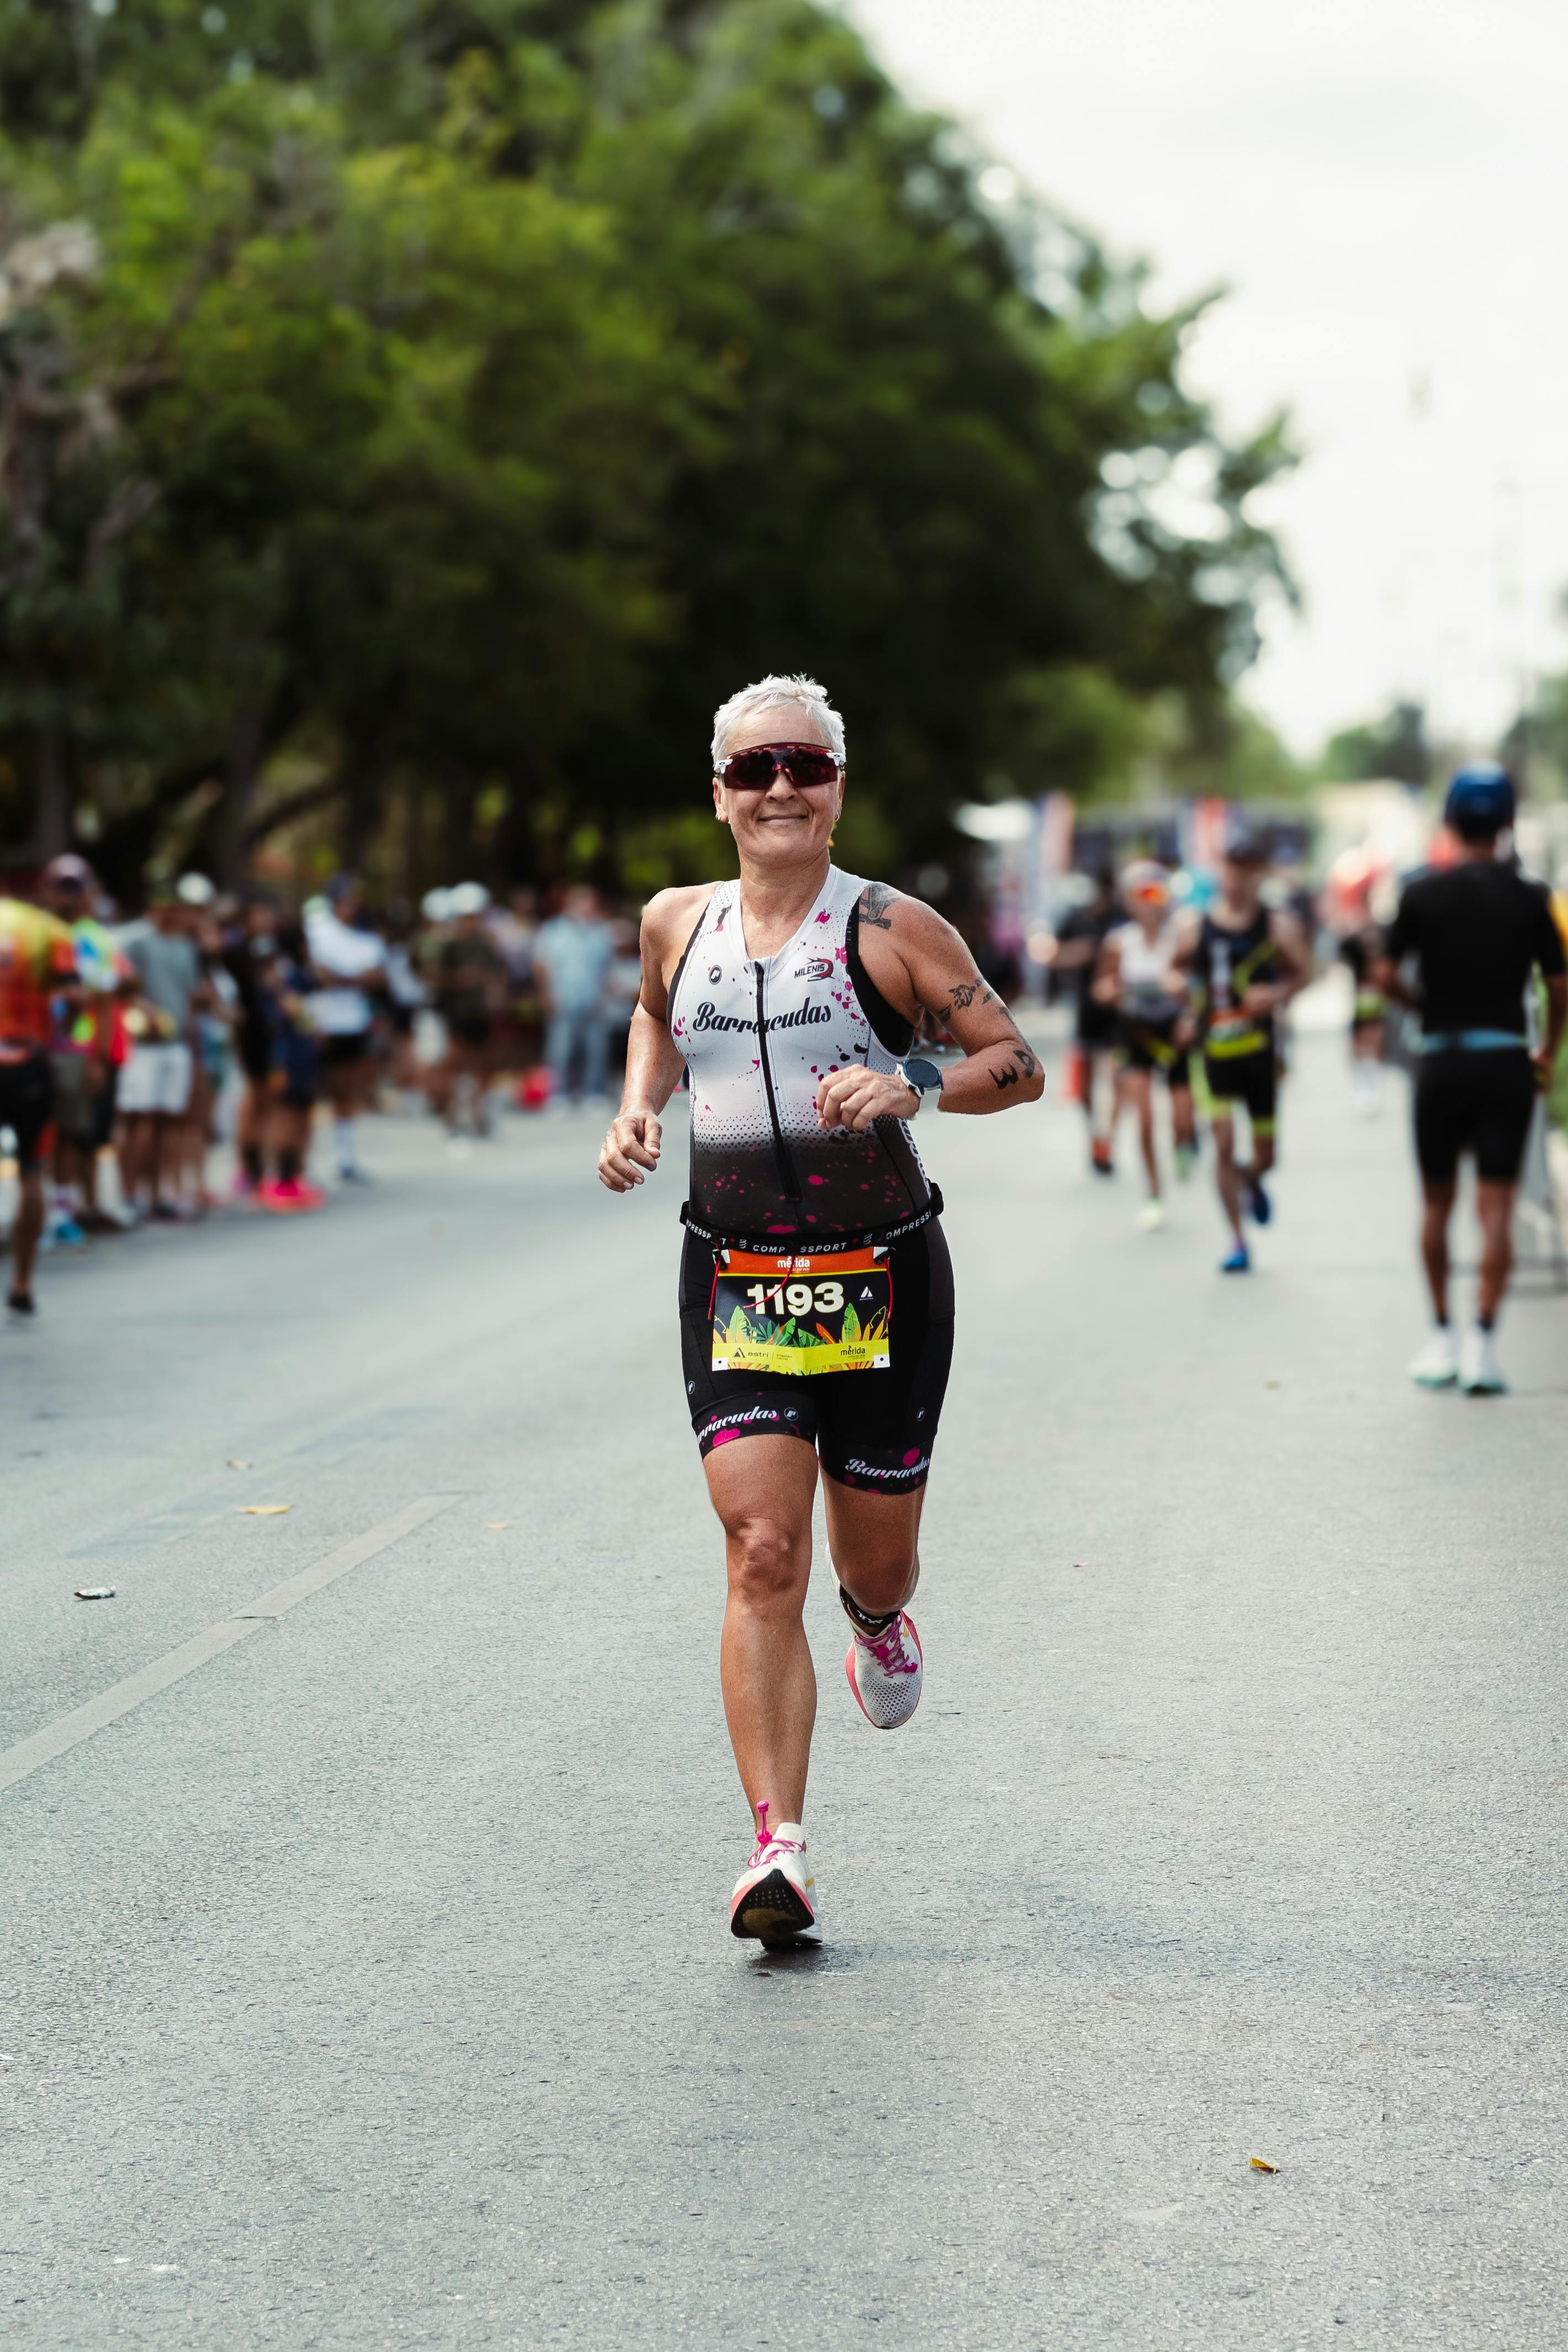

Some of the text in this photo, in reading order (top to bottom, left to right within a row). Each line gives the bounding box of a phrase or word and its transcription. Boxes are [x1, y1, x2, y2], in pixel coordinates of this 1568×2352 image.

[794, 963, 825, 979] MILENIS
[692, 997, 831, 1034] Barracudas
[777, 1256, 811, 1268] méida
[747, 1281, 844, 1316] 1193
[840, 1345, 866, 1356] mérida
